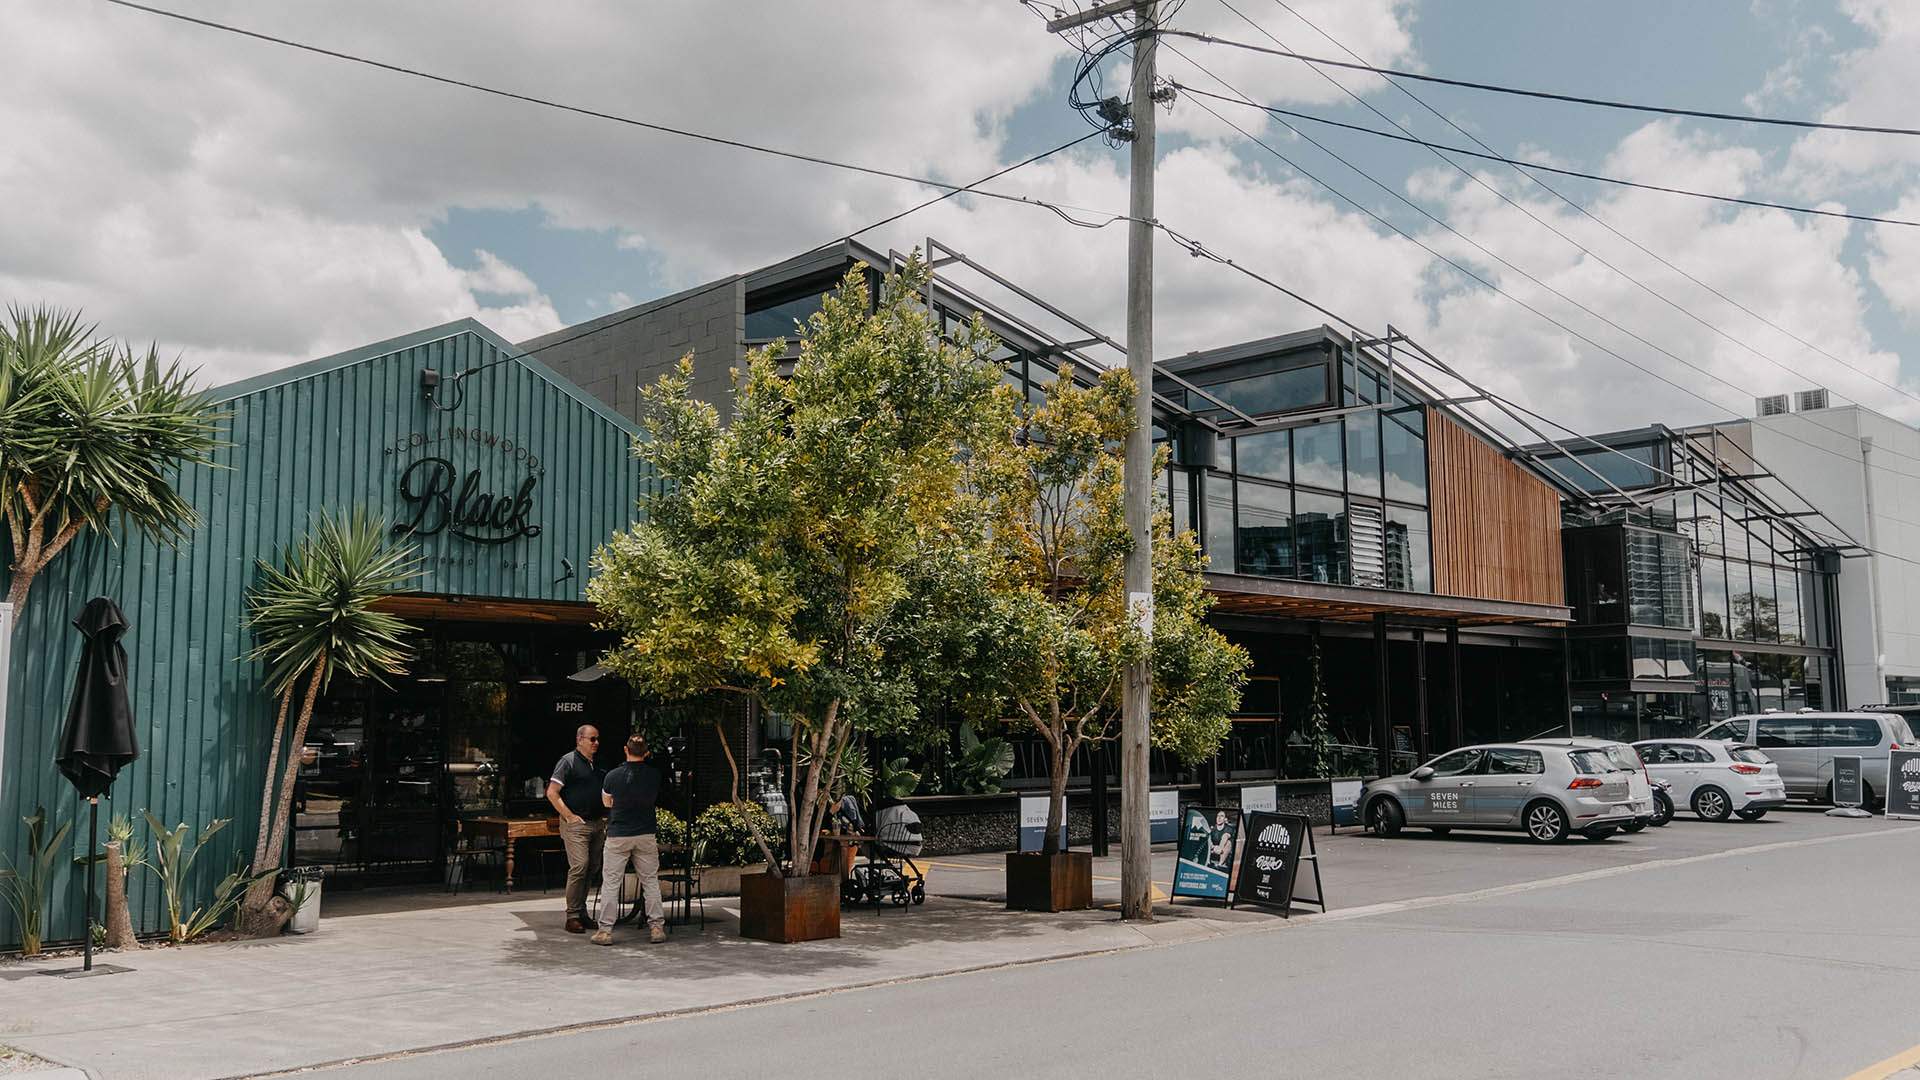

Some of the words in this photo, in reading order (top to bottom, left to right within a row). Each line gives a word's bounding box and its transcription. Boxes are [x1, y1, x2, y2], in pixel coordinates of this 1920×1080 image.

[396, 426, 539, 469] COLLINGWOOD
[391, 456, 543, 545] Black
[556, 702, 584, 712] HERE
[1430, 792, 1459, 801] SEVEN
[1432, 801, 1458, 809] MILES
